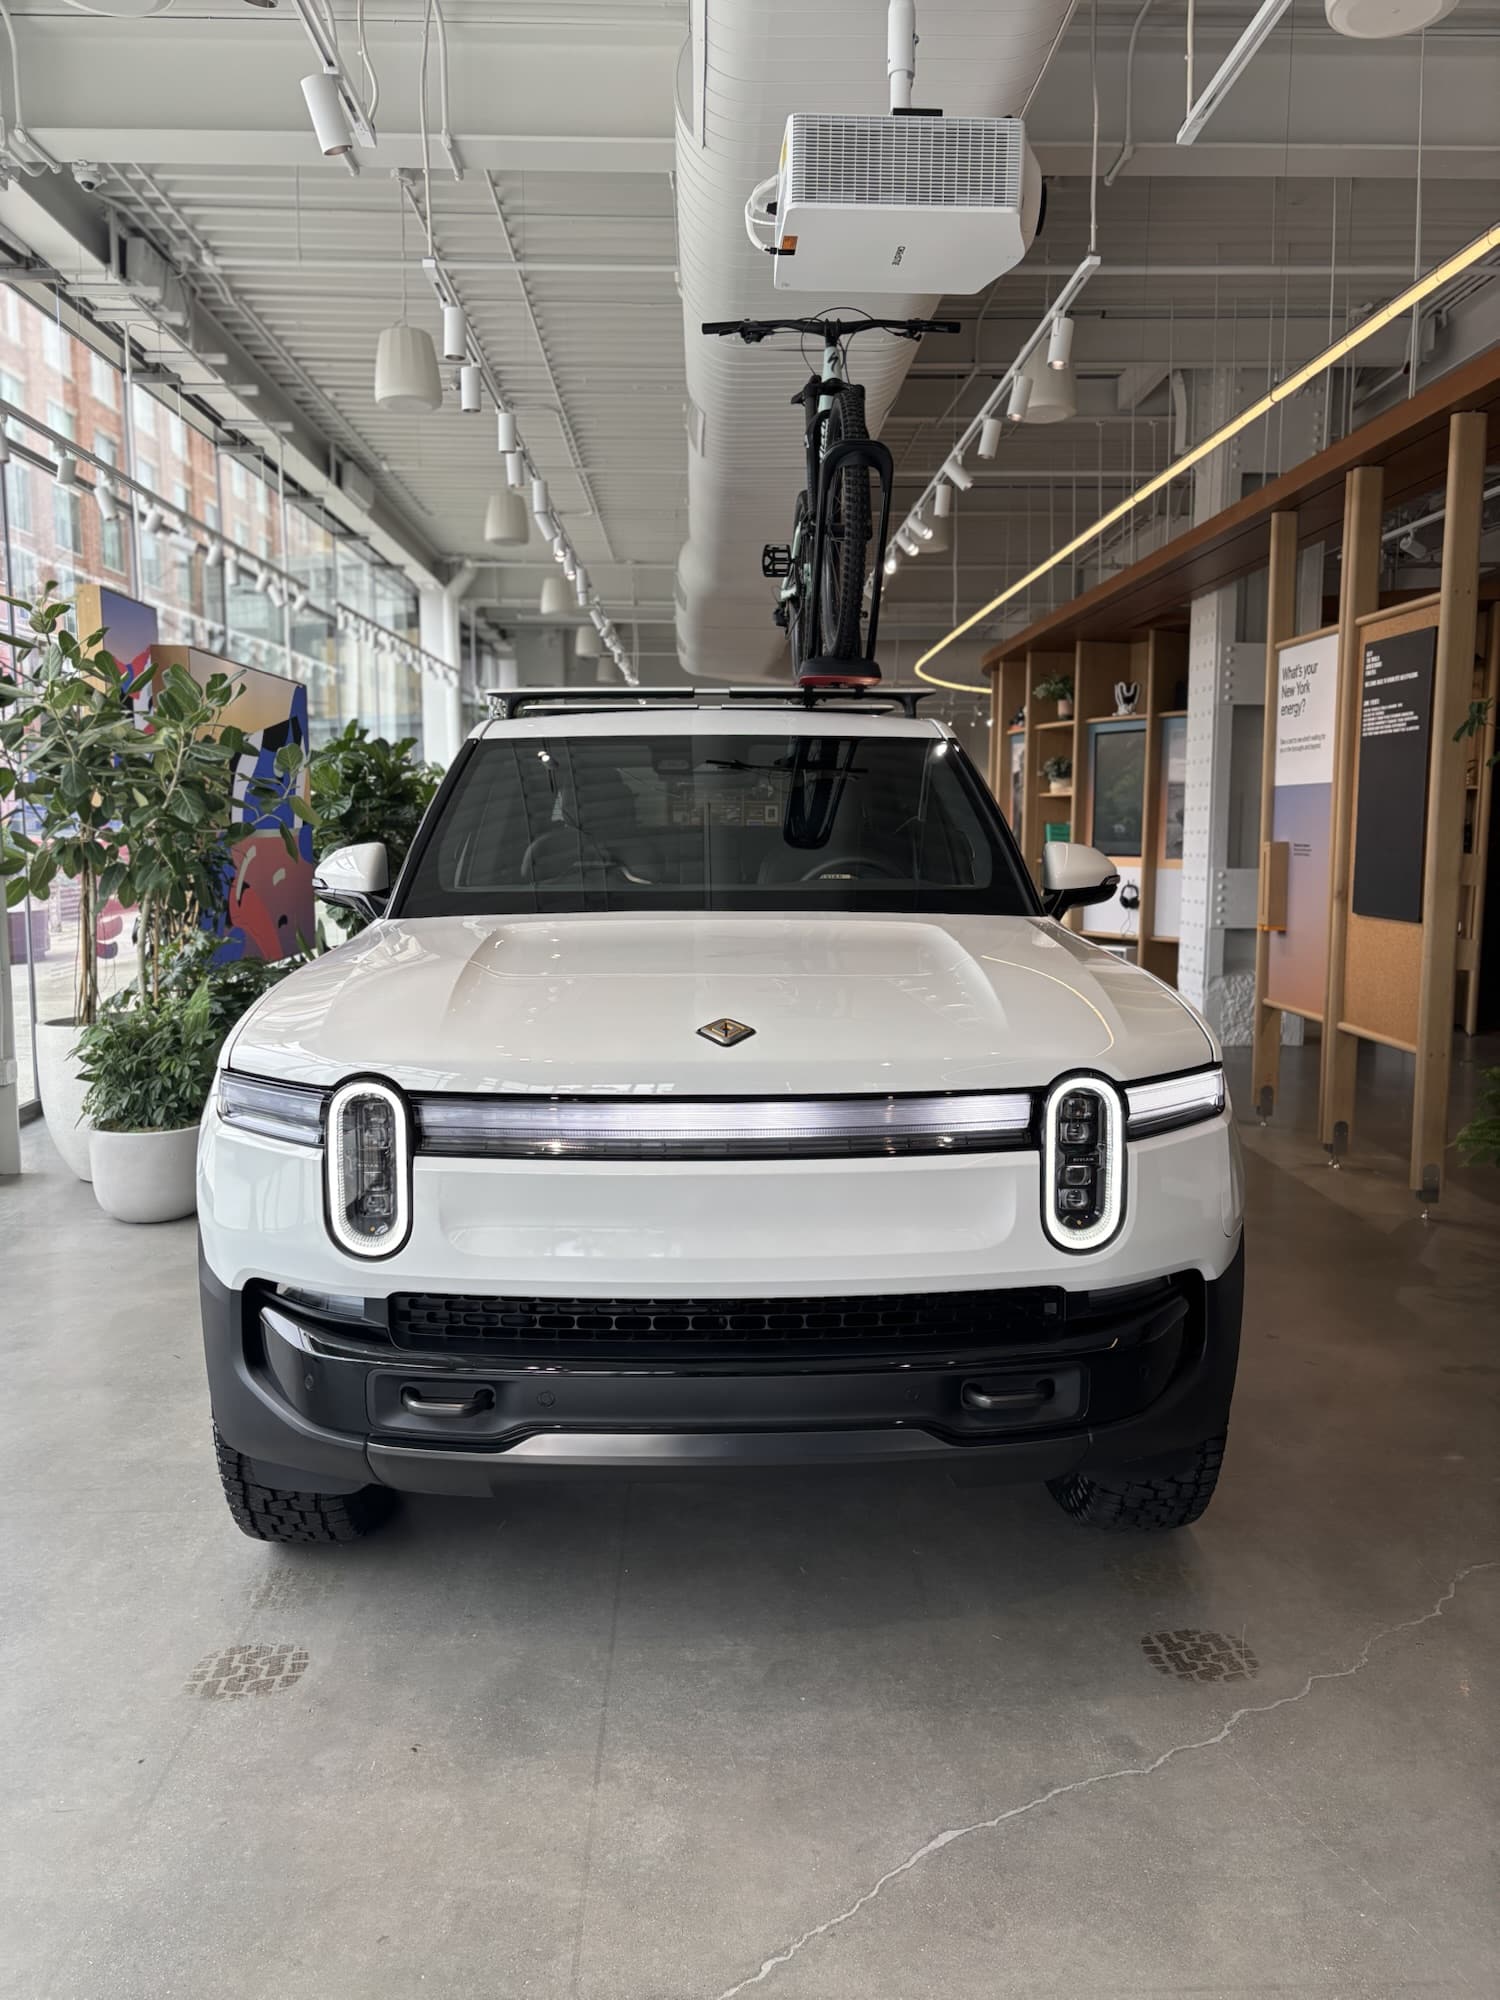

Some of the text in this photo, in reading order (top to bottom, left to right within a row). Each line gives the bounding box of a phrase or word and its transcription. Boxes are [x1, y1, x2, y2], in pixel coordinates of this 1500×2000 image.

[1303, 662, 1319, 680] your
[1281, 680, 1311, 699] New York
[1280, 698, 1306, 718] energy?
